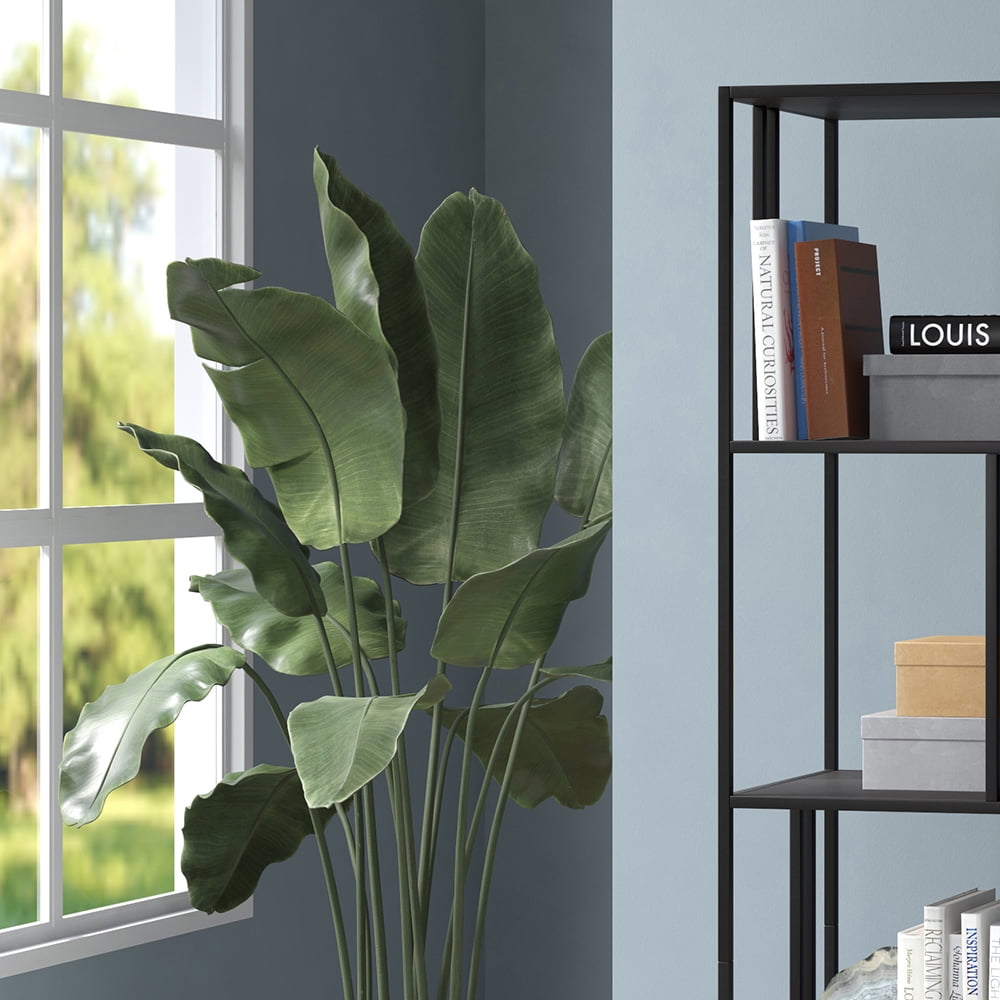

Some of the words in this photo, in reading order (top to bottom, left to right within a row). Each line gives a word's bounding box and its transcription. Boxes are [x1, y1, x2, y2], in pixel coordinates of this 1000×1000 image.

[813, 247, 822, 277] PROJECT
[759, 254, 774, 332] NATURAL
[910, 322, 990, 347] LOUIS
[762, 335, 779, 436] CURIOSITIES
[952, 945, 963, 988] Johanna
[966, 927, 979, 997] INSPIRATION
[991, 937, 1000, 963] THE
